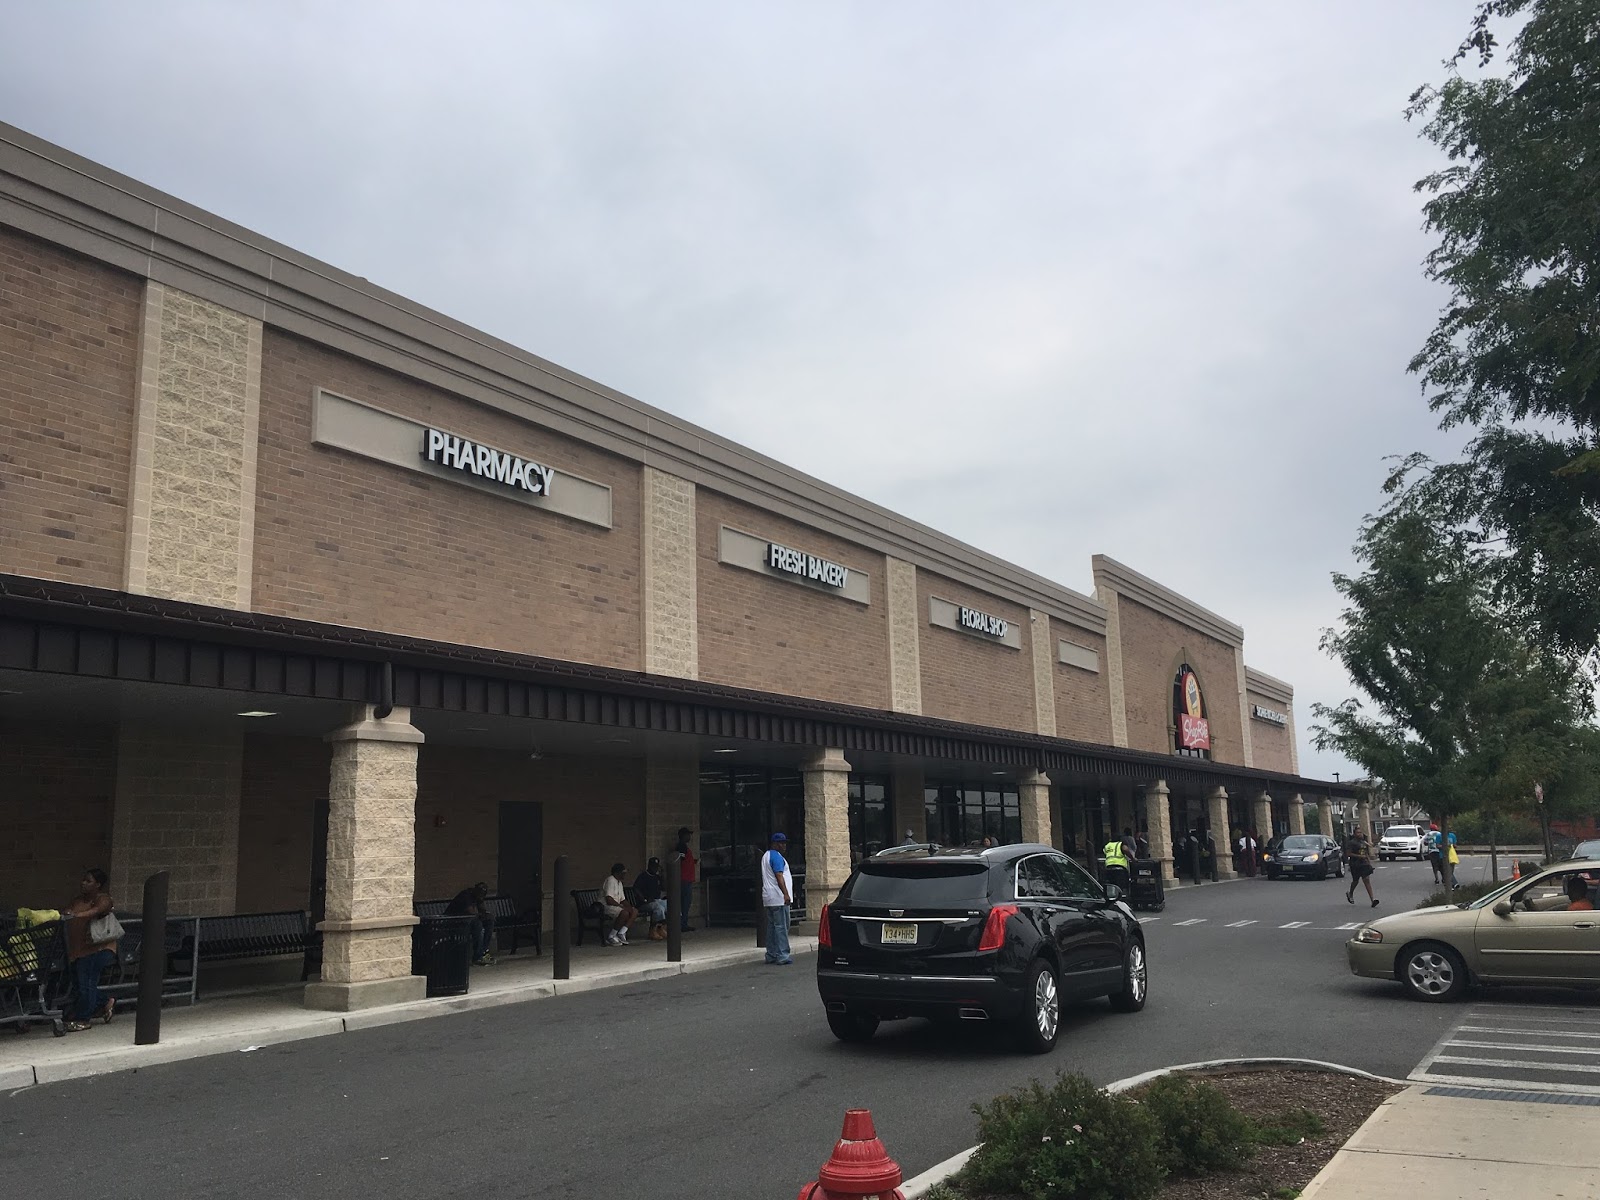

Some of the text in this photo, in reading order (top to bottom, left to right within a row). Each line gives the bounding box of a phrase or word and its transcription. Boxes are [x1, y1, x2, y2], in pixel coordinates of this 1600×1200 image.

[427, 428, 555, 496] PHARMACY
[771, 543, 849, 589] FRESH BAKERY
[961, 607, 1008, 638] FLORAL SHOP
